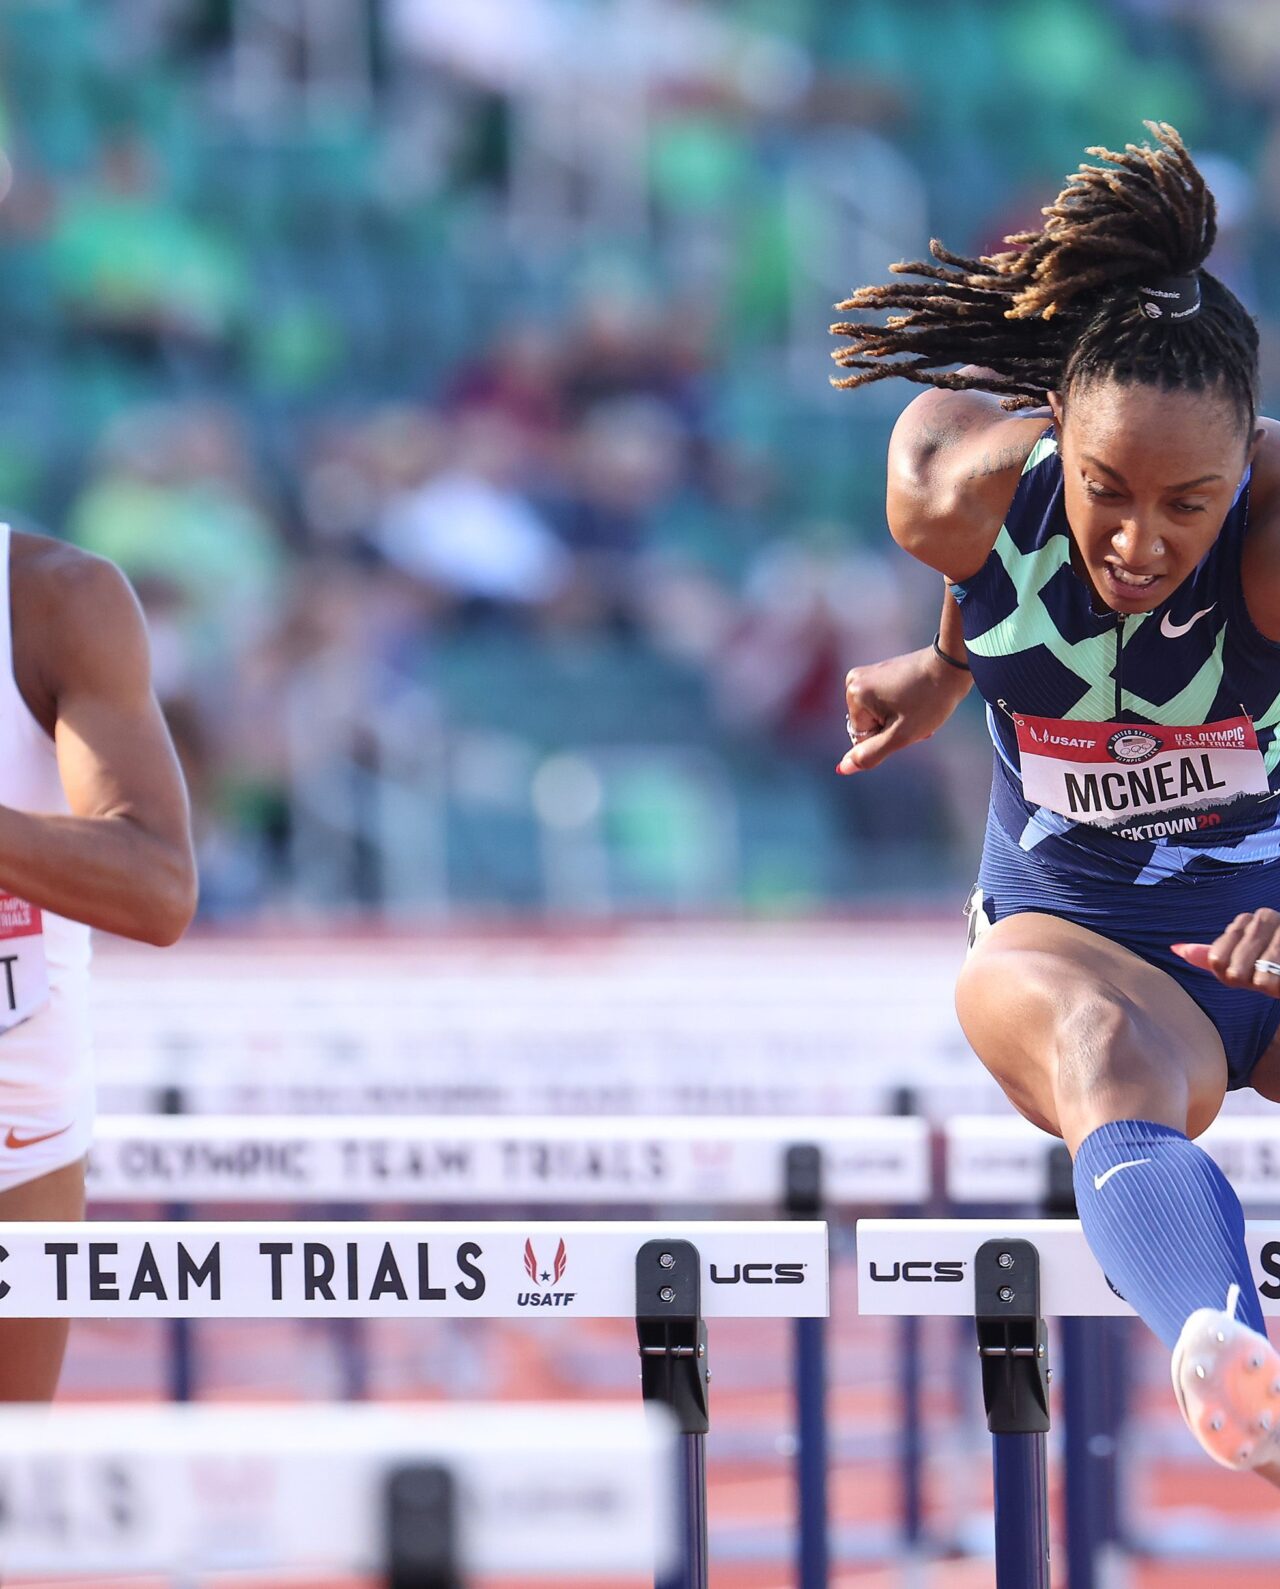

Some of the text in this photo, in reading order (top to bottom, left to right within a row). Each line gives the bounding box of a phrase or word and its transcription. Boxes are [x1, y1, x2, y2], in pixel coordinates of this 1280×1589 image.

[1050, 735, 1097, 749] USATF
[1174, 726, 1245, 742] U.S. OLYMPIC
[1064, 753, 1227, 813] MCNEAL
[45, 1242, 220, 1300] TEAM
[260, 1242, 485, 1300] TRIALS
[710, 1263, 807, 1285] UCS
[869, 1261, 967, 1283] UCS
[517, 1293, 576, 1306] USATF
